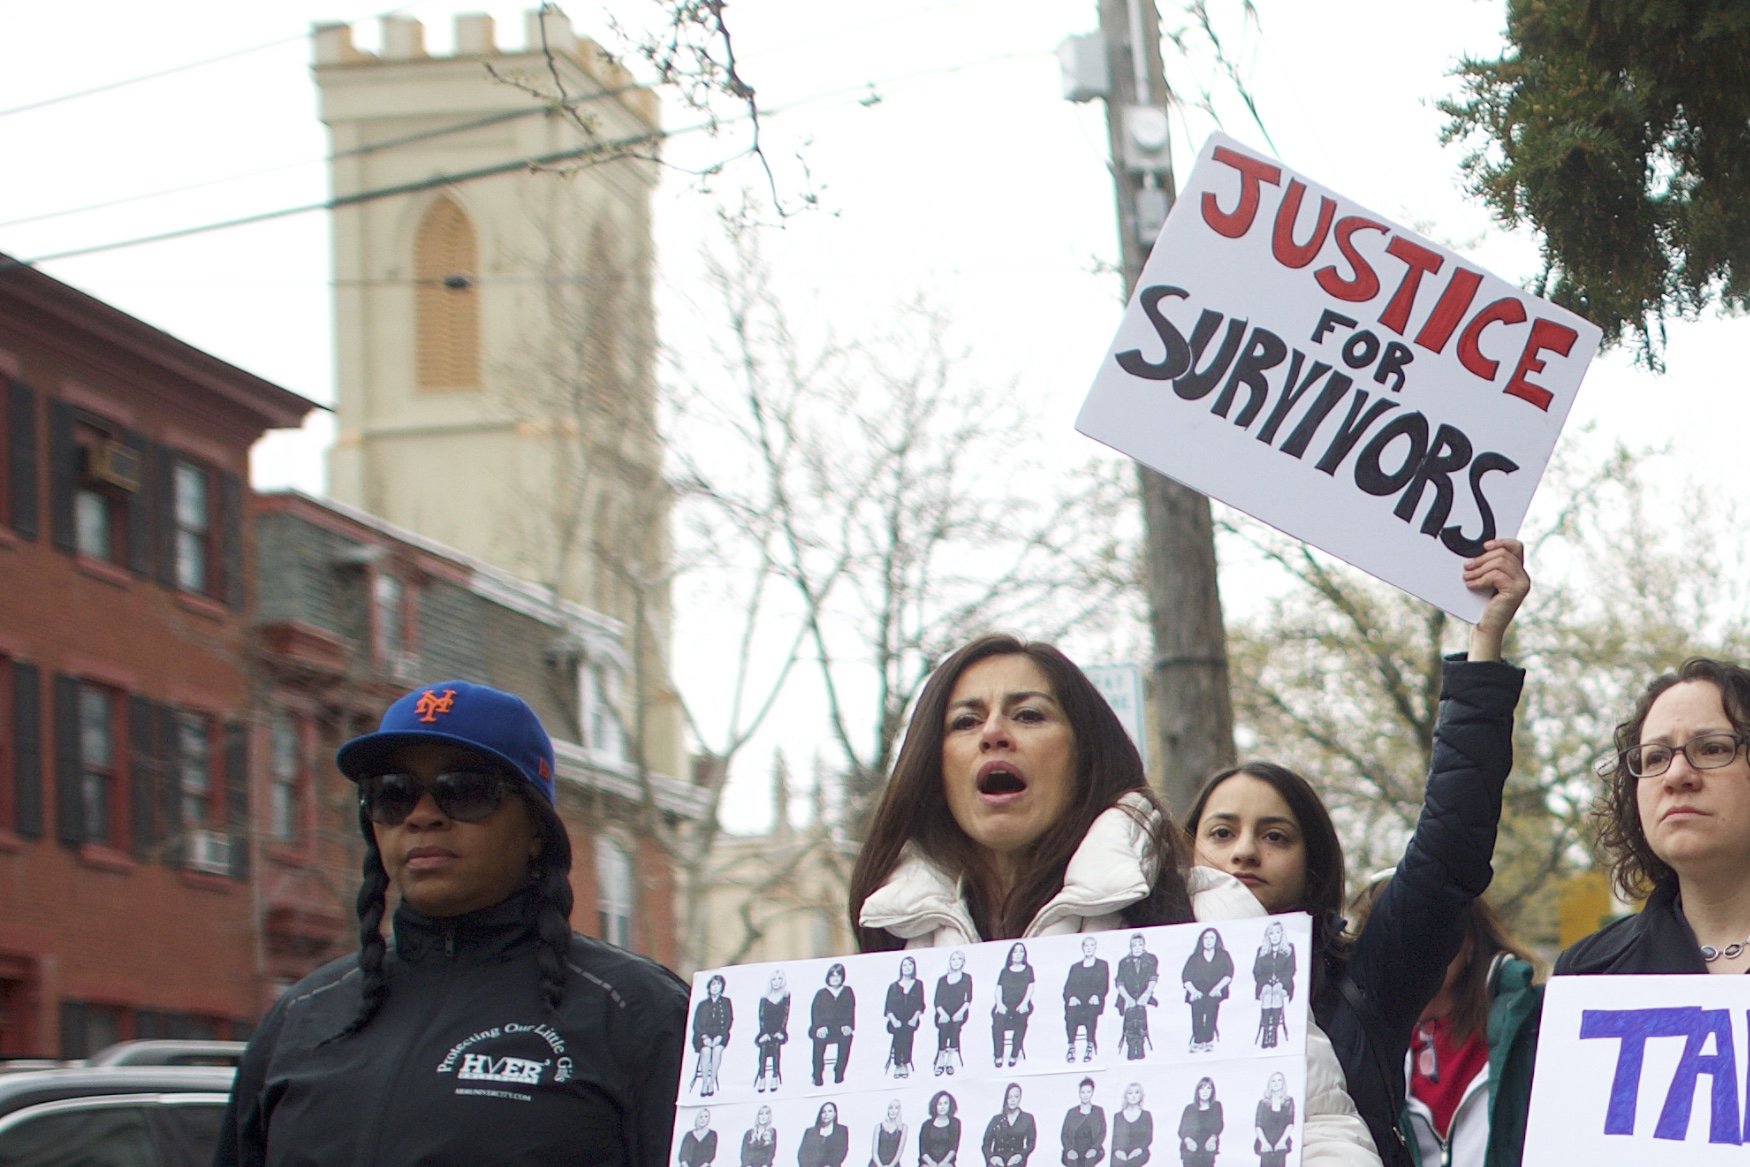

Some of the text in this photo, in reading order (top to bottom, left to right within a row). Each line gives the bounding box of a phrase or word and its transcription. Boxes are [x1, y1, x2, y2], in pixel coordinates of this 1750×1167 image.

[1200, 145, 1579, 412] JUSTICE
[1311, 308, 1414, 392] FOR
[1115, 284, 1519, 558] SURVIVORS
[436, 1027, 501, 1073] Protecting
[504, 1022, 535, 1034] Our
[533, 1023, 566, 1055] Little
